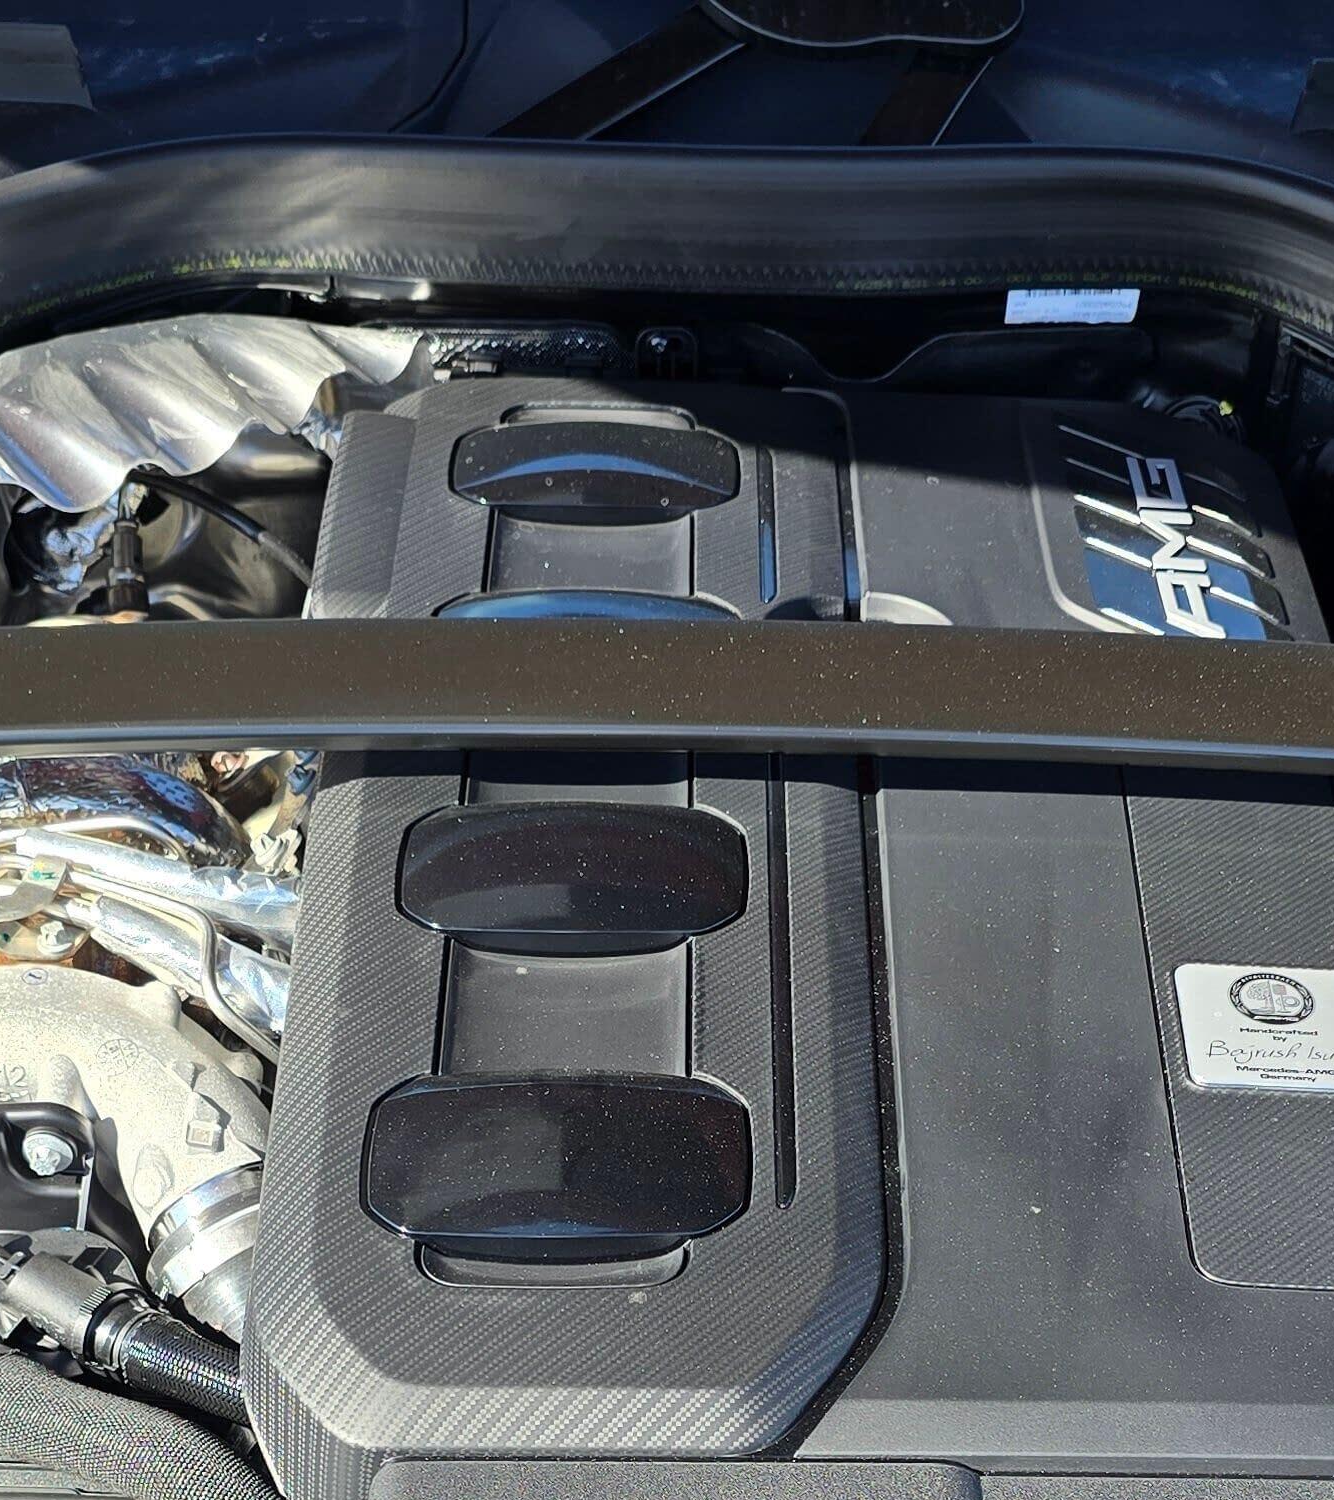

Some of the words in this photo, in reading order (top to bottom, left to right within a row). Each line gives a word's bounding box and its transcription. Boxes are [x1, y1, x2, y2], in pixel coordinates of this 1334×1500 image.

[1125, 457, 1227, 639] AMG
[1239, 1027, 1319, 1036] Handcrafted
[1272, 1034, 1287, 1042] by
[1260, 1073, 1317, 1082] Germany
